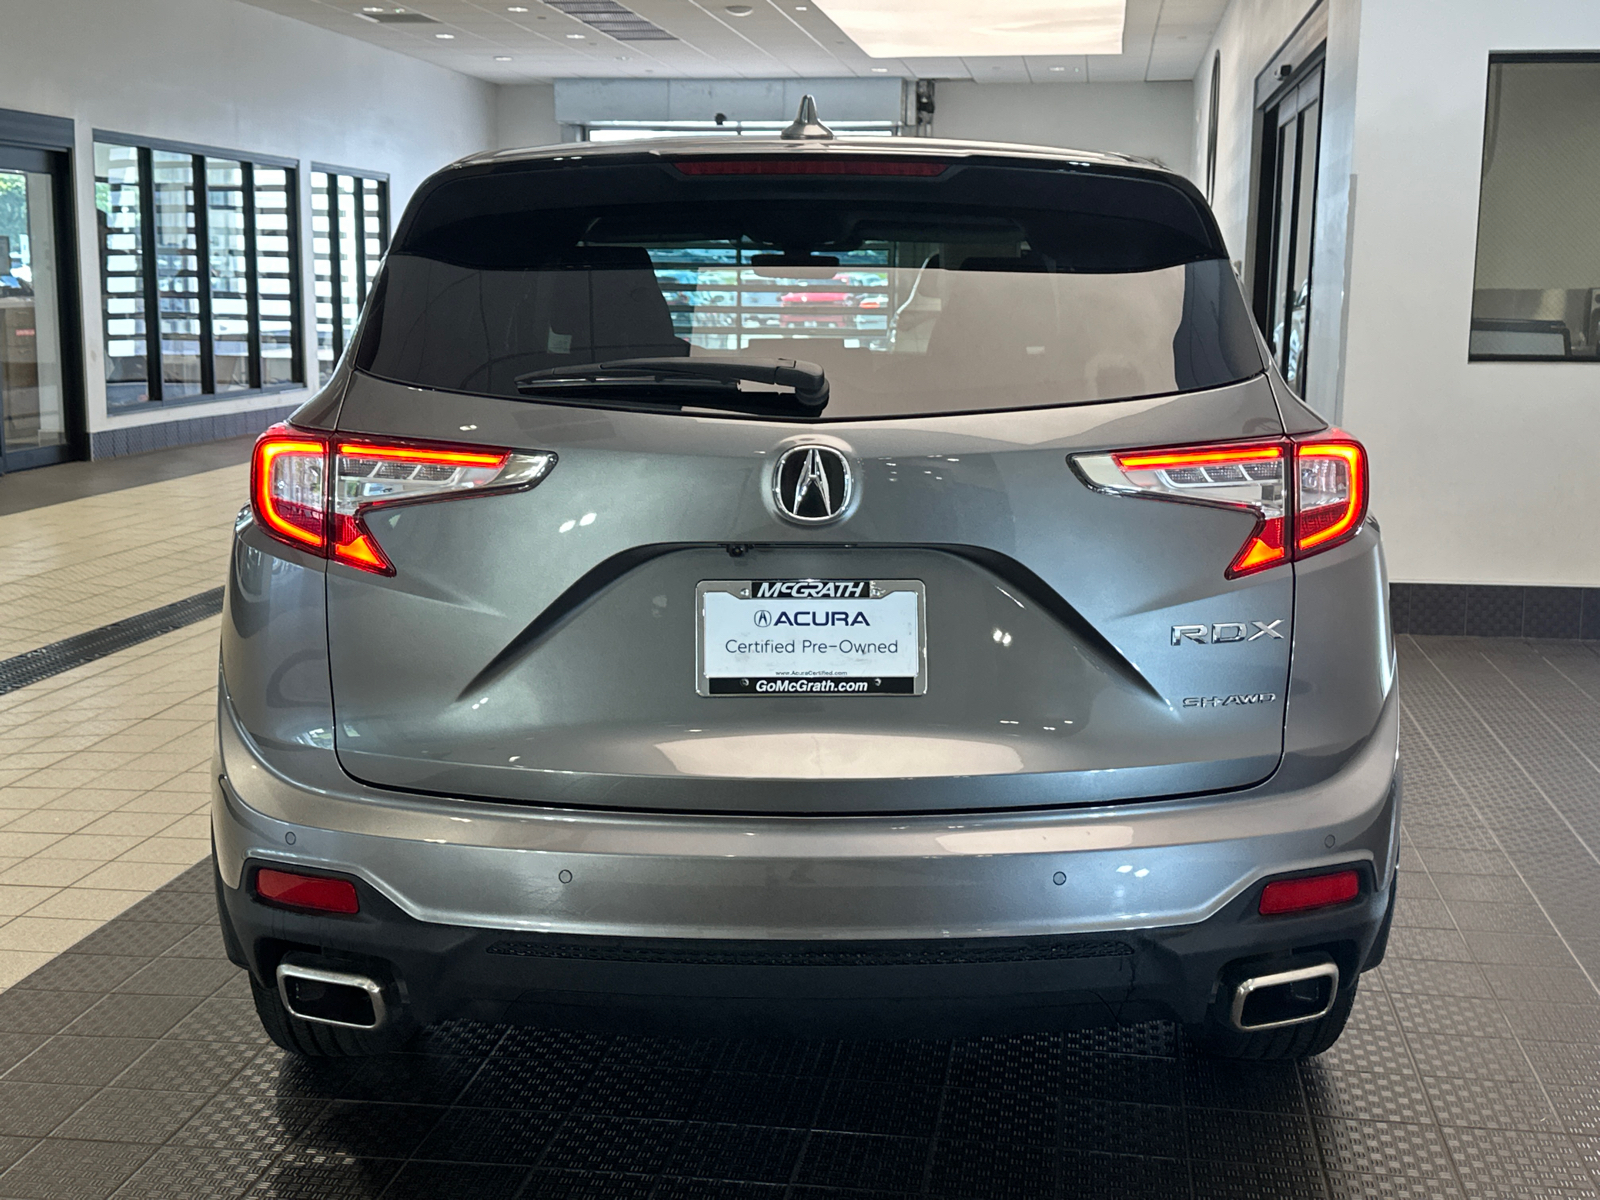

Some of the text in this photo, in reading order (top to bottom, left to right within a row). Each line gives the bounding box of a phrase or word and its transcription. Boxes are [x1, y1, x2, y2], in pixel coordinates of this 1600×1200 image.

[773, 611, 870, 627] ACURA
[1170, 619, 1285, 646] RDX
[725, 639, 898, 654] Certified Pre-Owned
[755, 679, 868, 693] GoMcGrath.com
